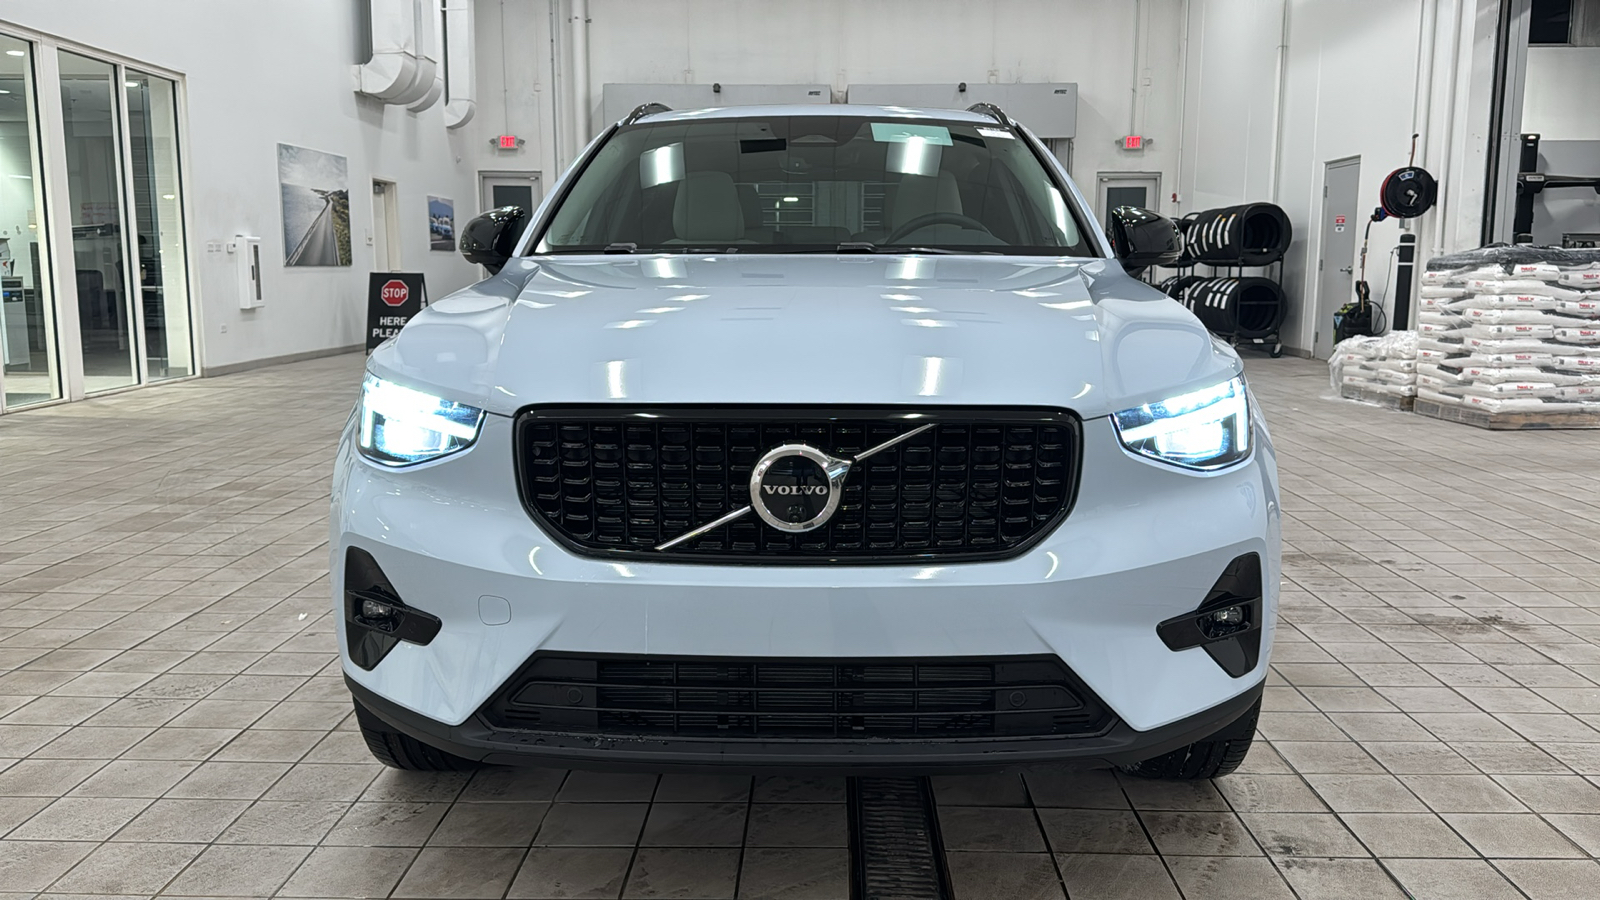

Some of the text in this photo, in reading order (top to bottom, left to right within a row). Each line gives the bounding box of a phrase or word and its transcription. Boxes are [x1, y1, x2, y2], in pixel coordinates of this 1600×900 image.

[500, 135, 515, 147] EXIT
[1126, 136, 1141, 148] EXIT
[383, 288, 407, 298] STOP
[379, 316, 407, 326] HERE
[372, 328, 400, 338] PLEA
[762, 484, 828, 496] VOLVO
